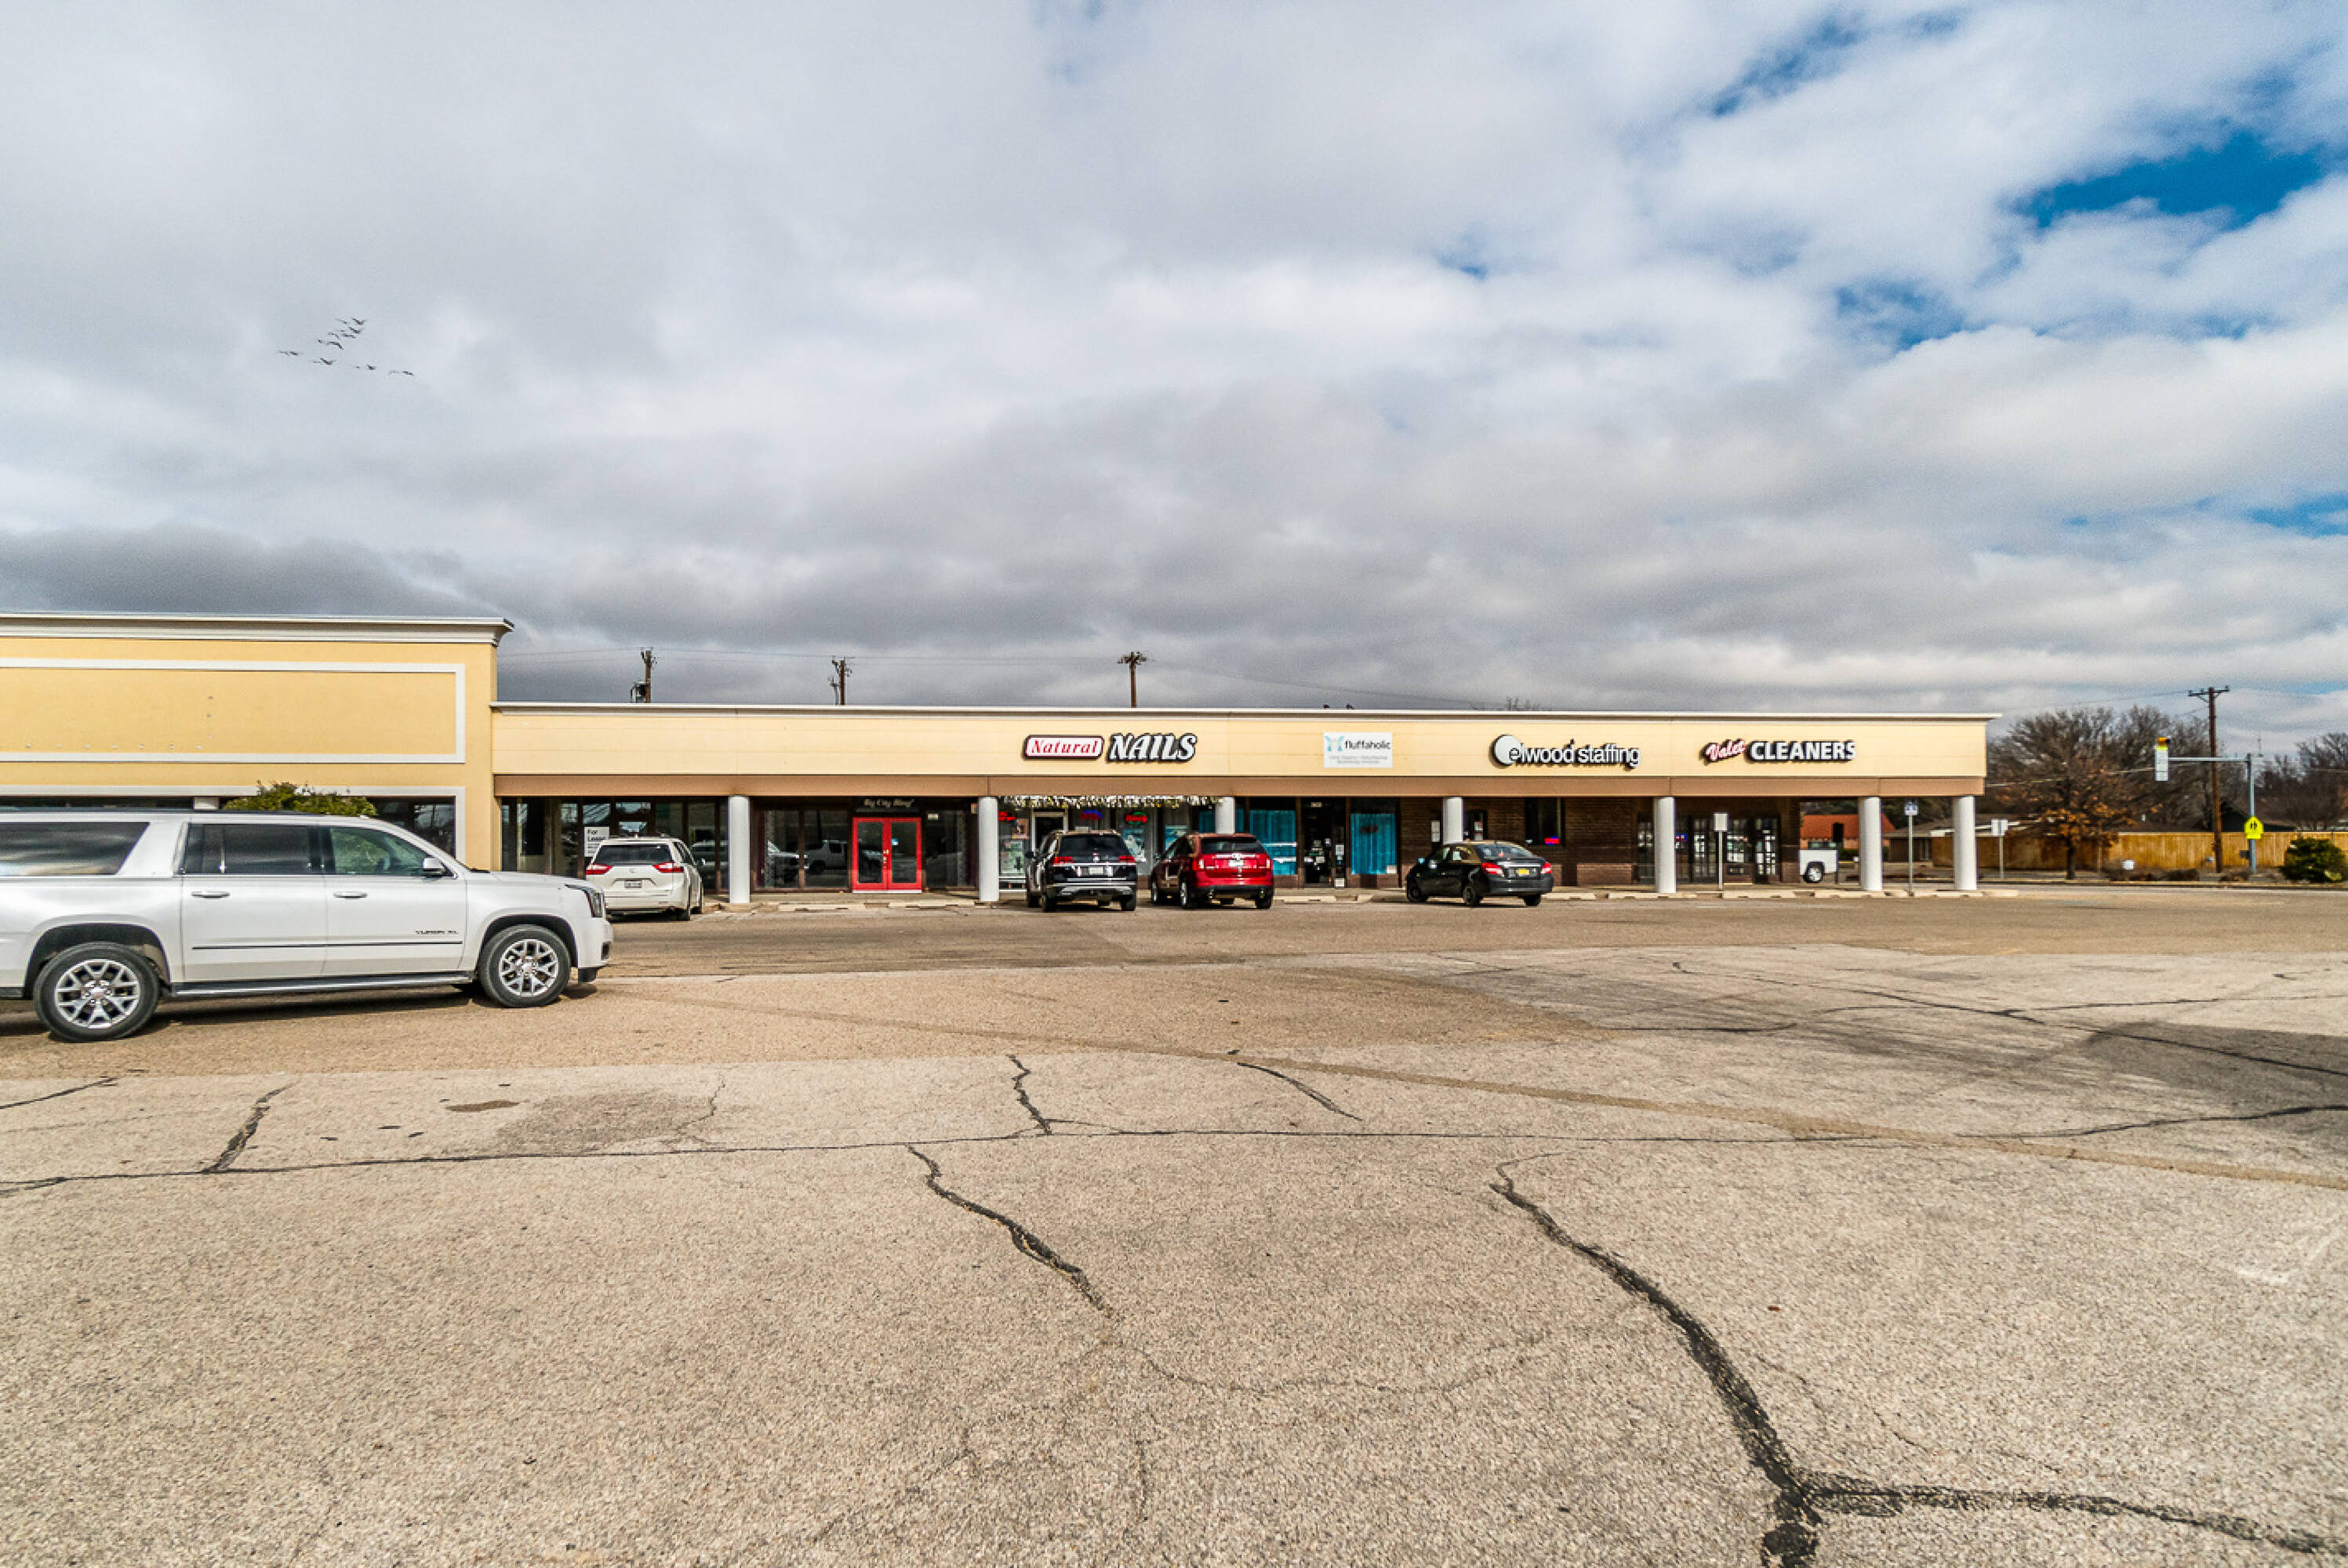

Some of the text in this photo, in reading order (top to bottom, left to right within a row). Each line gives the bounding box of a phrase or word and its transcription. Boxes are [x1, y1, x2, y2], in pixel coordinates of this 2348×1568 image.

[1030, 734, 1197, 760] Natural NAILS
[1577, 743, 1641, 767] staffing
[1703, 739, 1857, 761] Valet CLEANERS
